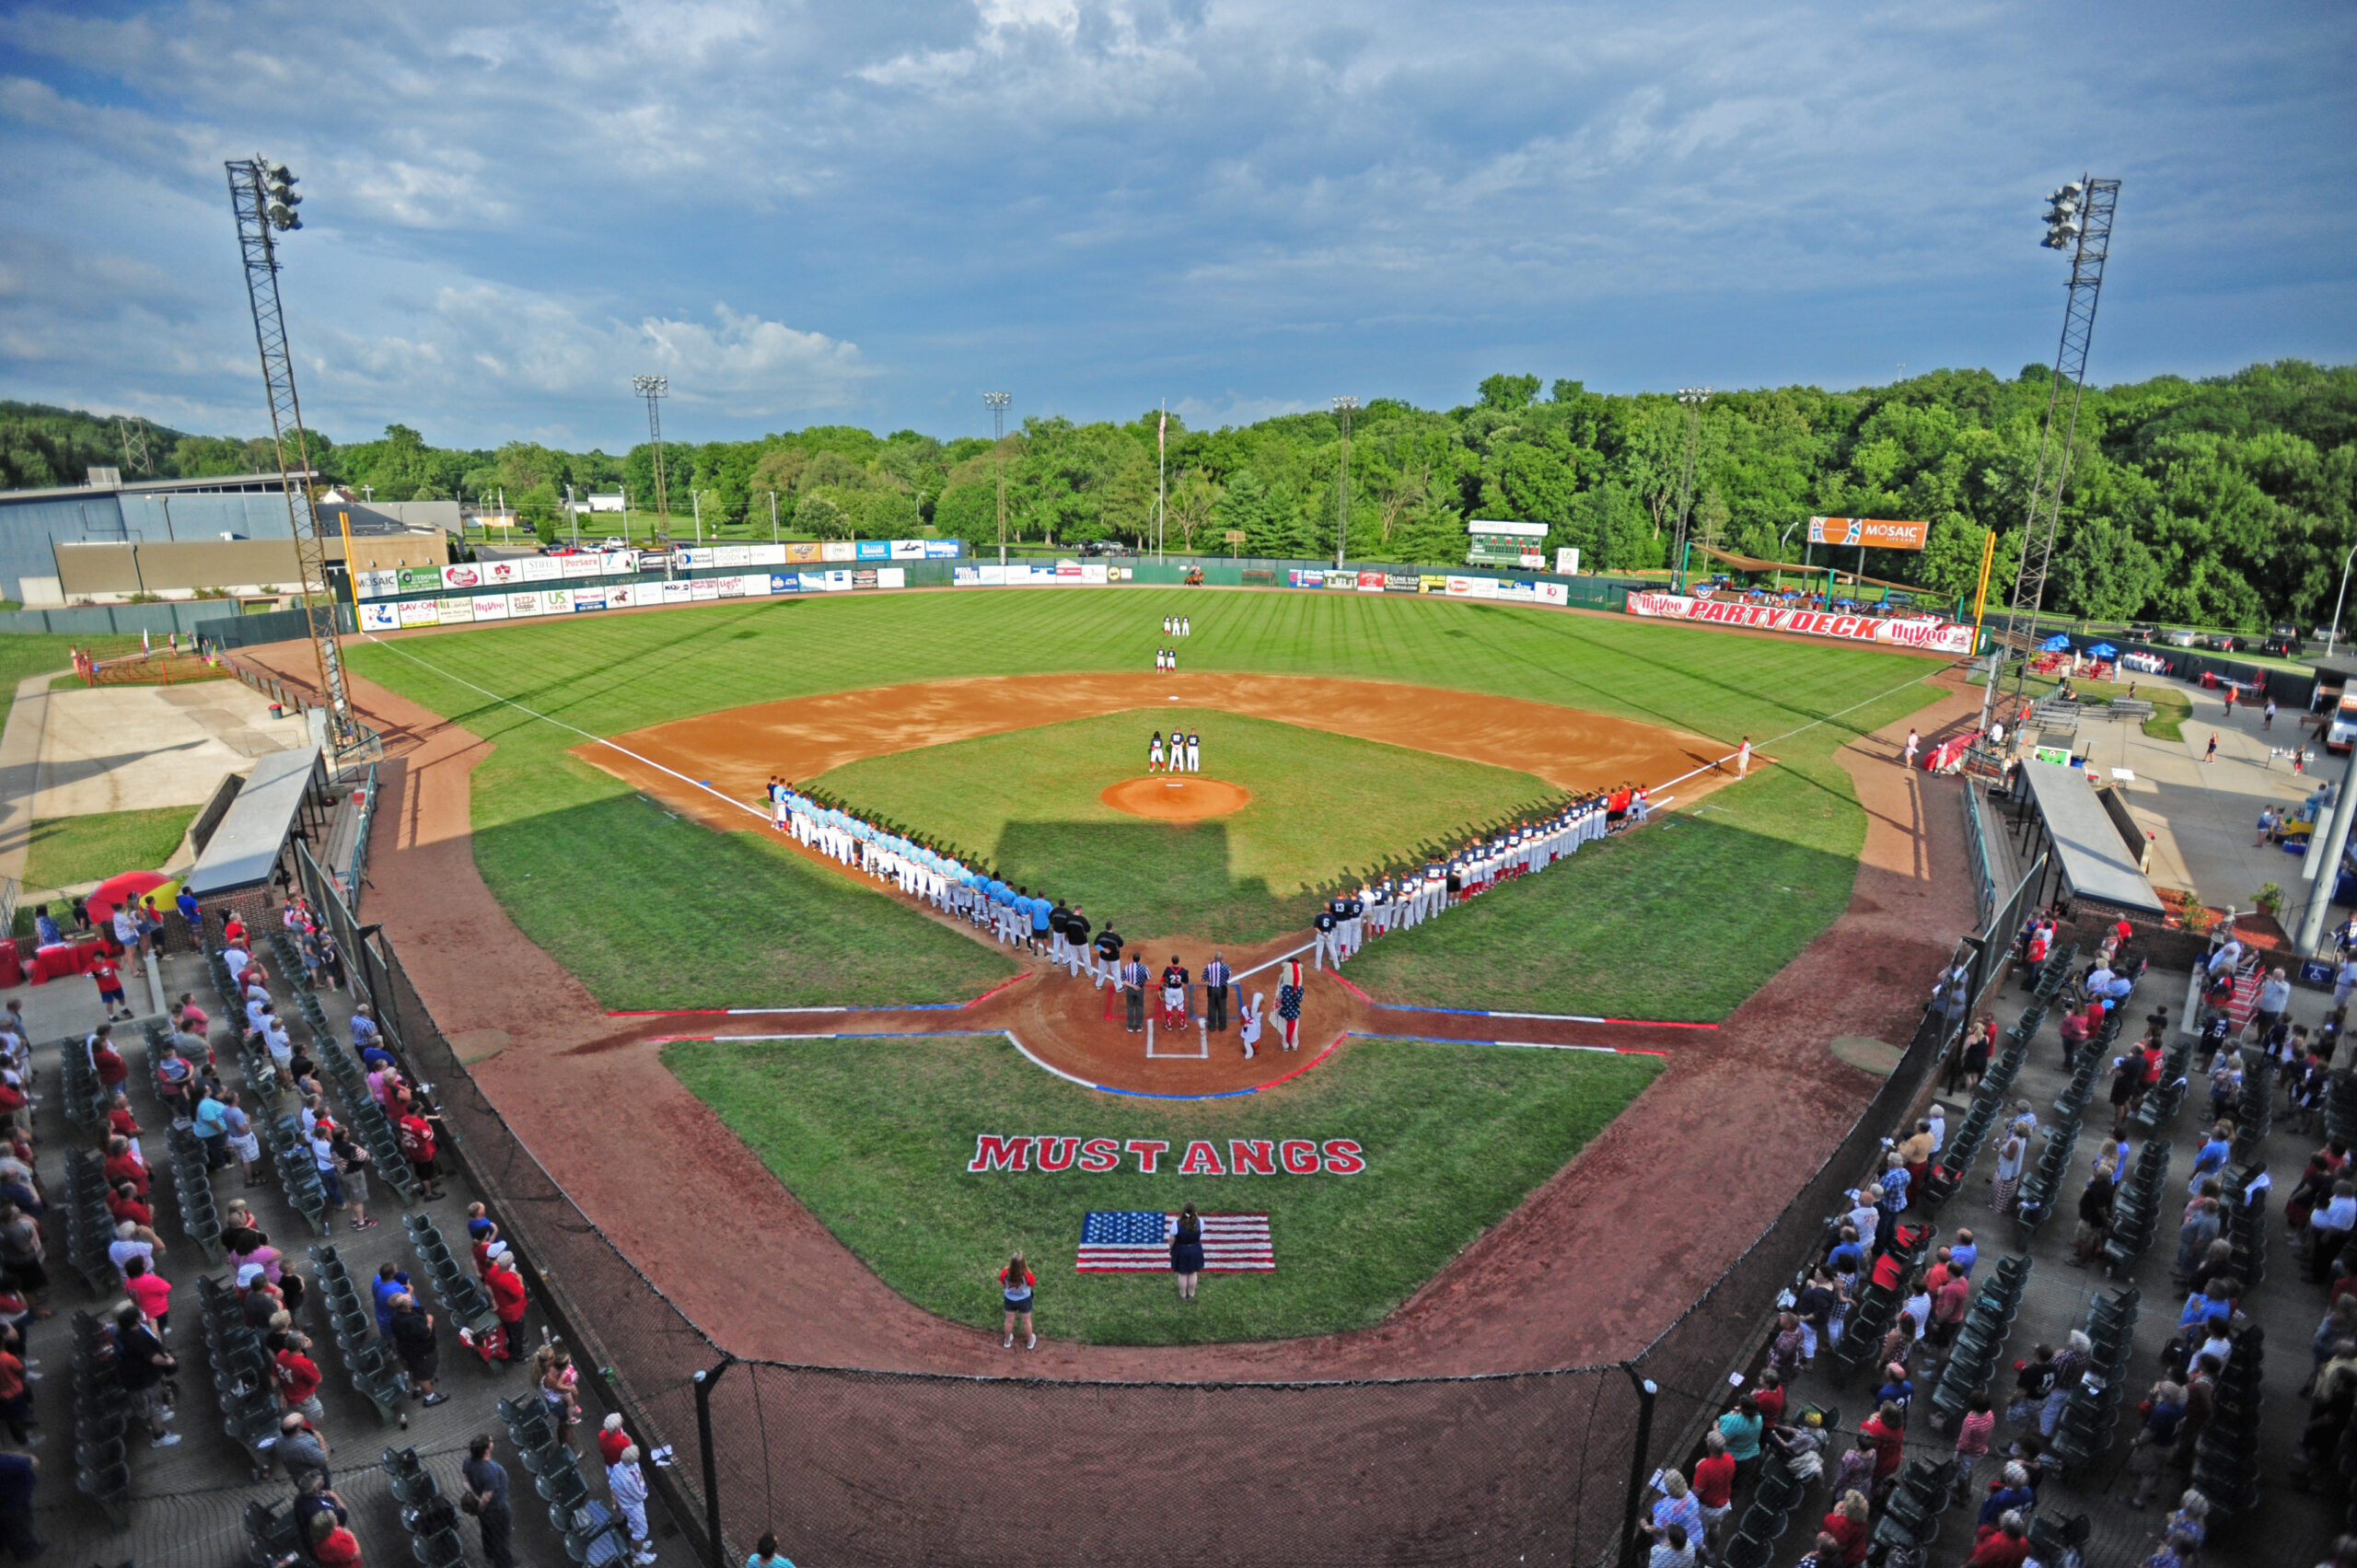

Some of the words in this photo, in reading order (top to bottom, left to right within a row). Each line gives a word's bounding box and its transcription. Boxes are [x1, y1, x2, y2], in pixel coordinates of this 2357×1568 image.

[1865, 525, 1918, 539] MOSAIC
[528, 559, 553, 568] STIFEL
[357, 576, 395, 587] MOSAIC
[514, 596, 536, 604] PIZZA
[548, 591, 566, 604] US
[1642, 596, 1682, 613] HyVee
[1687, 598, 1791, 629] PARTY
[1789, 610, 1887, 641] DECK
[1892, 622, 1948, 645] HyVee
[1428, 868, 1440, 877] 22
[1335, 903, 1344, 912] 13
[1353, 904, 1360, 913] 6
[1323, 918, 1329, 927] 6
[967, 1134, 1366, 1176] MUSTANGS
